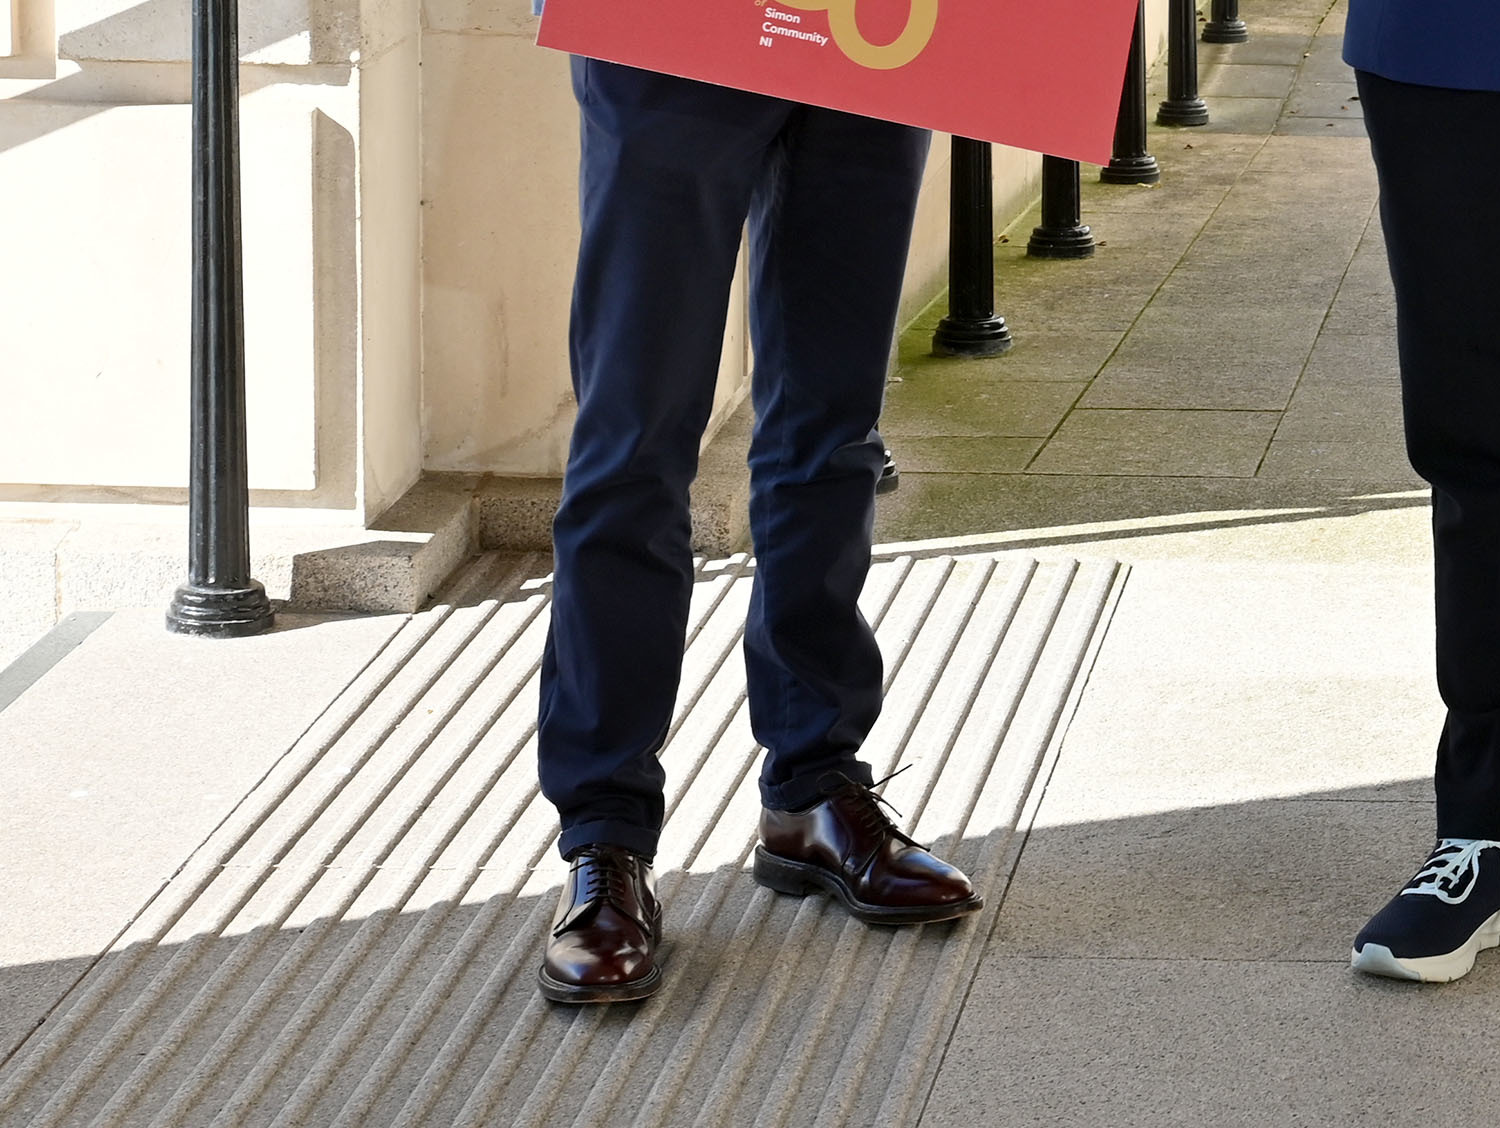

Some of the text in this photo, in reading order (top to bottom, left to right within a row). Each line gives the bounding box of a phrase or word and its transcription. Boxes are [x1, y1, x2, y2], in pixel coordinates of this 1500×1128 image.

[754, 0, 768, 7] of
[764, 7, 801, 24] Simon
[759, 35, 773, 48] NI
[762, 21, 829, 47] Community
